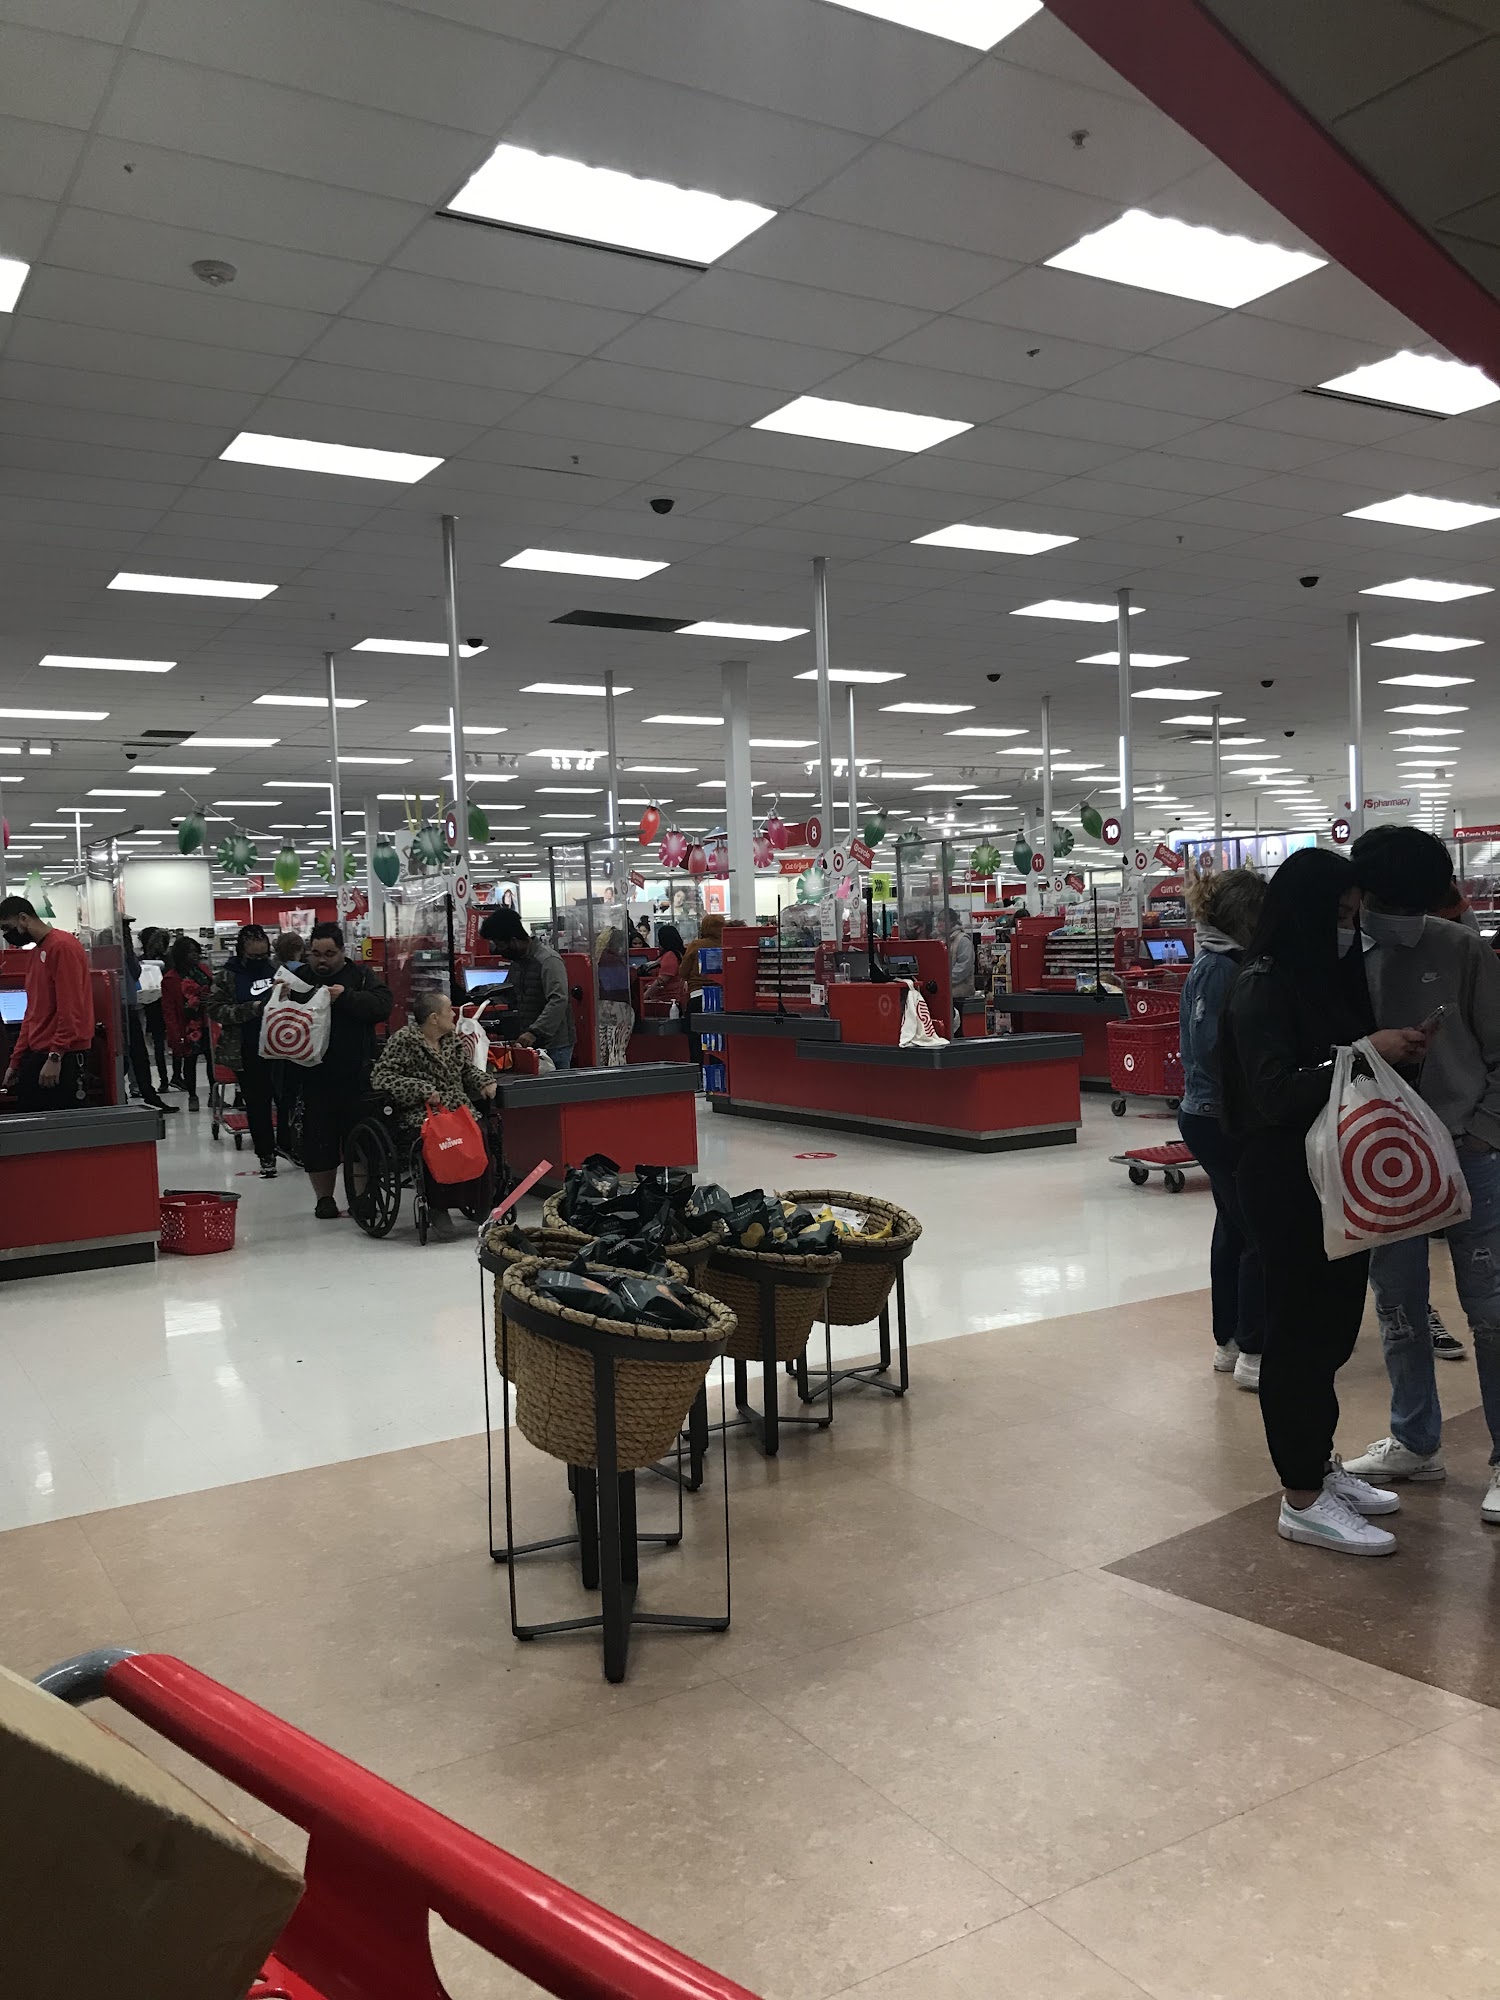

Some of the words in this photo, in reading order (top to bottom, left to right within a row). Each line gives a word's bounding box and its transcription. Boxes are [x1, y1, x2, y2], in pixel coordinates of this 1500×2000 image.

[448, 821, 455, 838] 6
[811, 825, 818, 840] 8
[1105, 824, 1119, 839] 10
[1335, 824, 1349, 839] 12
[605, 862, 611, 874] 7
[1034, 858, 1043, 868] 11
[1202, 856, 1211, 866] 13
[1160, 885, 1173, 894] Gift
[438, 1137, 464, 1151] Wawa
